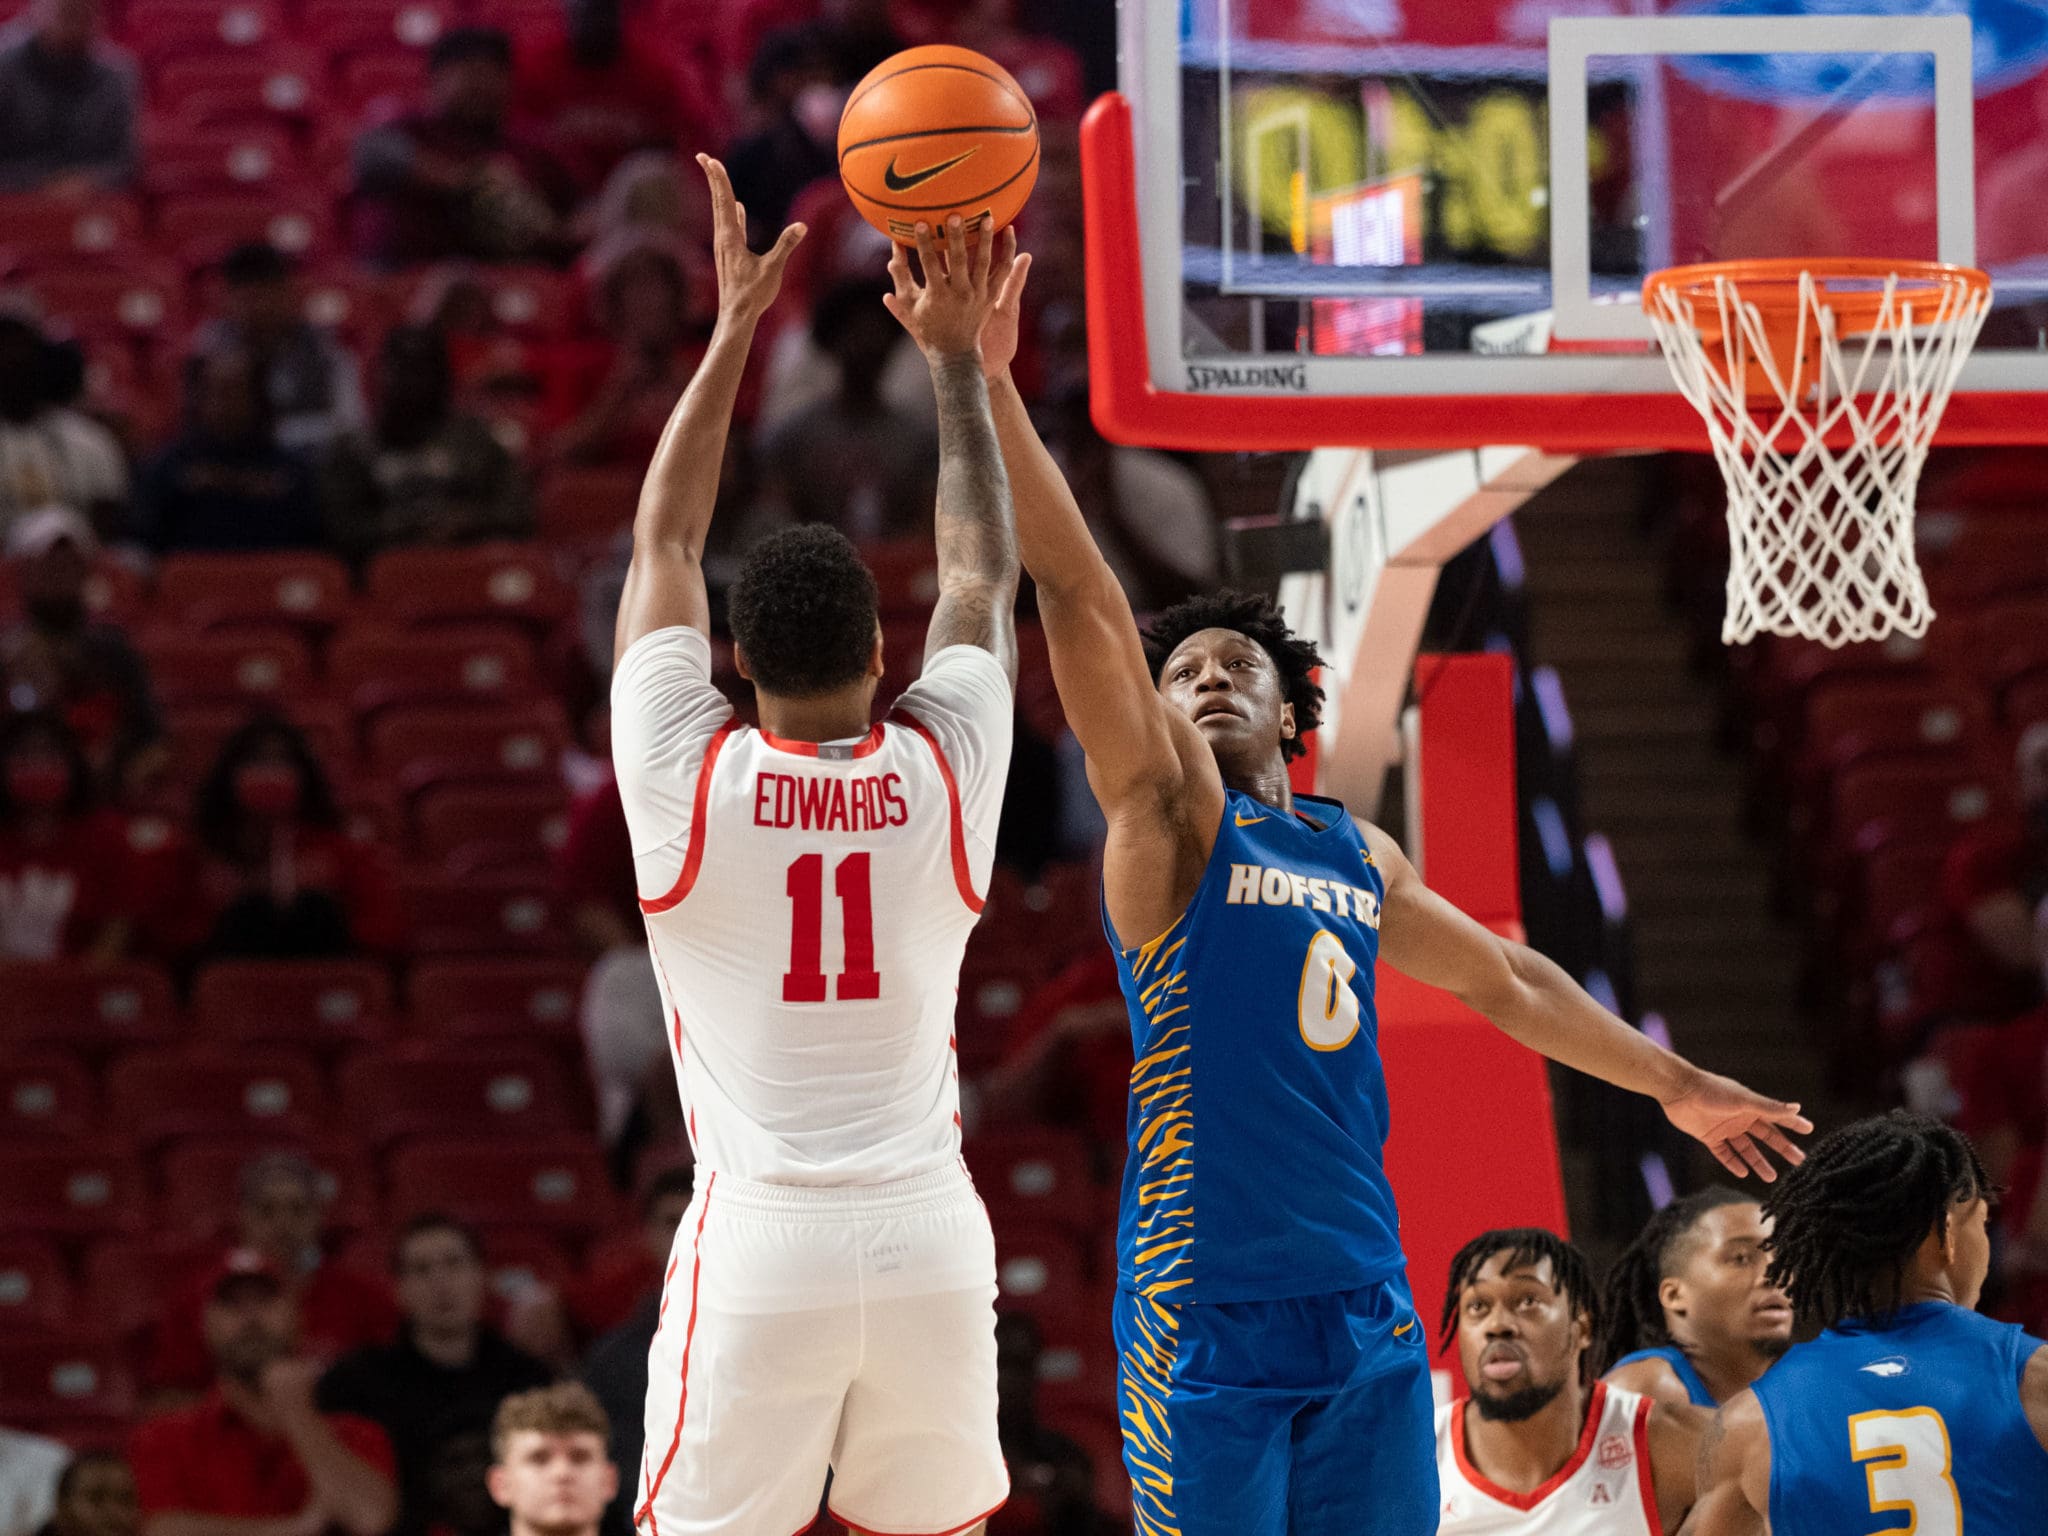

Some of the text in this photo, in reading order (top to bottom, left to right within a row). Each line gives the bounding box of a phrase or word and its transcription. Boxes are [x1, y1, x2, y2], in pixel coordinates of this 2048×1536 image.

[1186, 365, 1307, 392] SPALDING
[753, 771, 909, 832] EDWARDS
[782, 851, 881, 1003] 11
[1226, 862, 1381, 931] HOFSTR
[1297, 928, 1361, 1053] 0
[1847, 1405, 1965, 1536] 3
